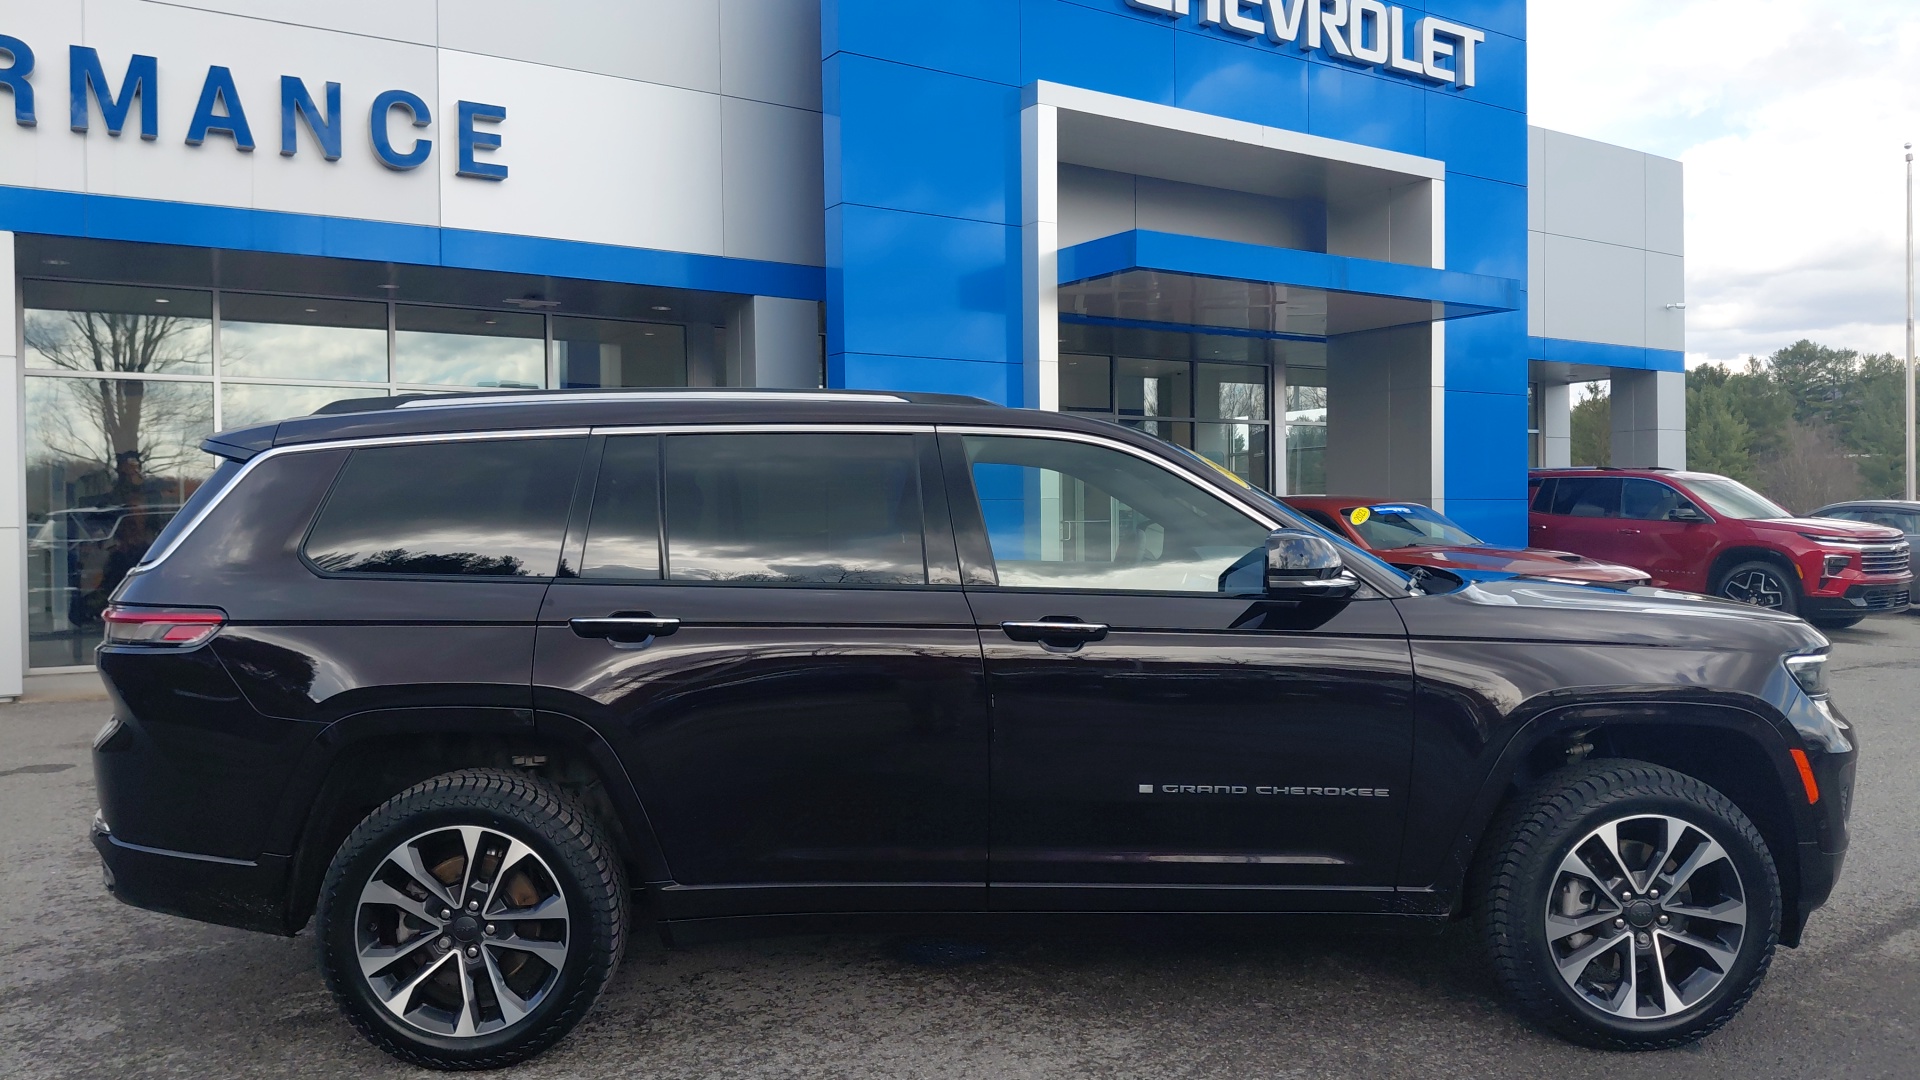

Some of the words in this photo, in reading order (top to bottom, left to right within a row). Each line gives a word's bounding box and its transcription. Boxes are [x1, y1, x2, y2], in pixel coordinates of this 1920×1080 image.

[0, 34, 509, 182] RMANCE
[1162, 784, 1248, 794] GRAND
[1255, 786, 1390, 797] CHEROKEE
